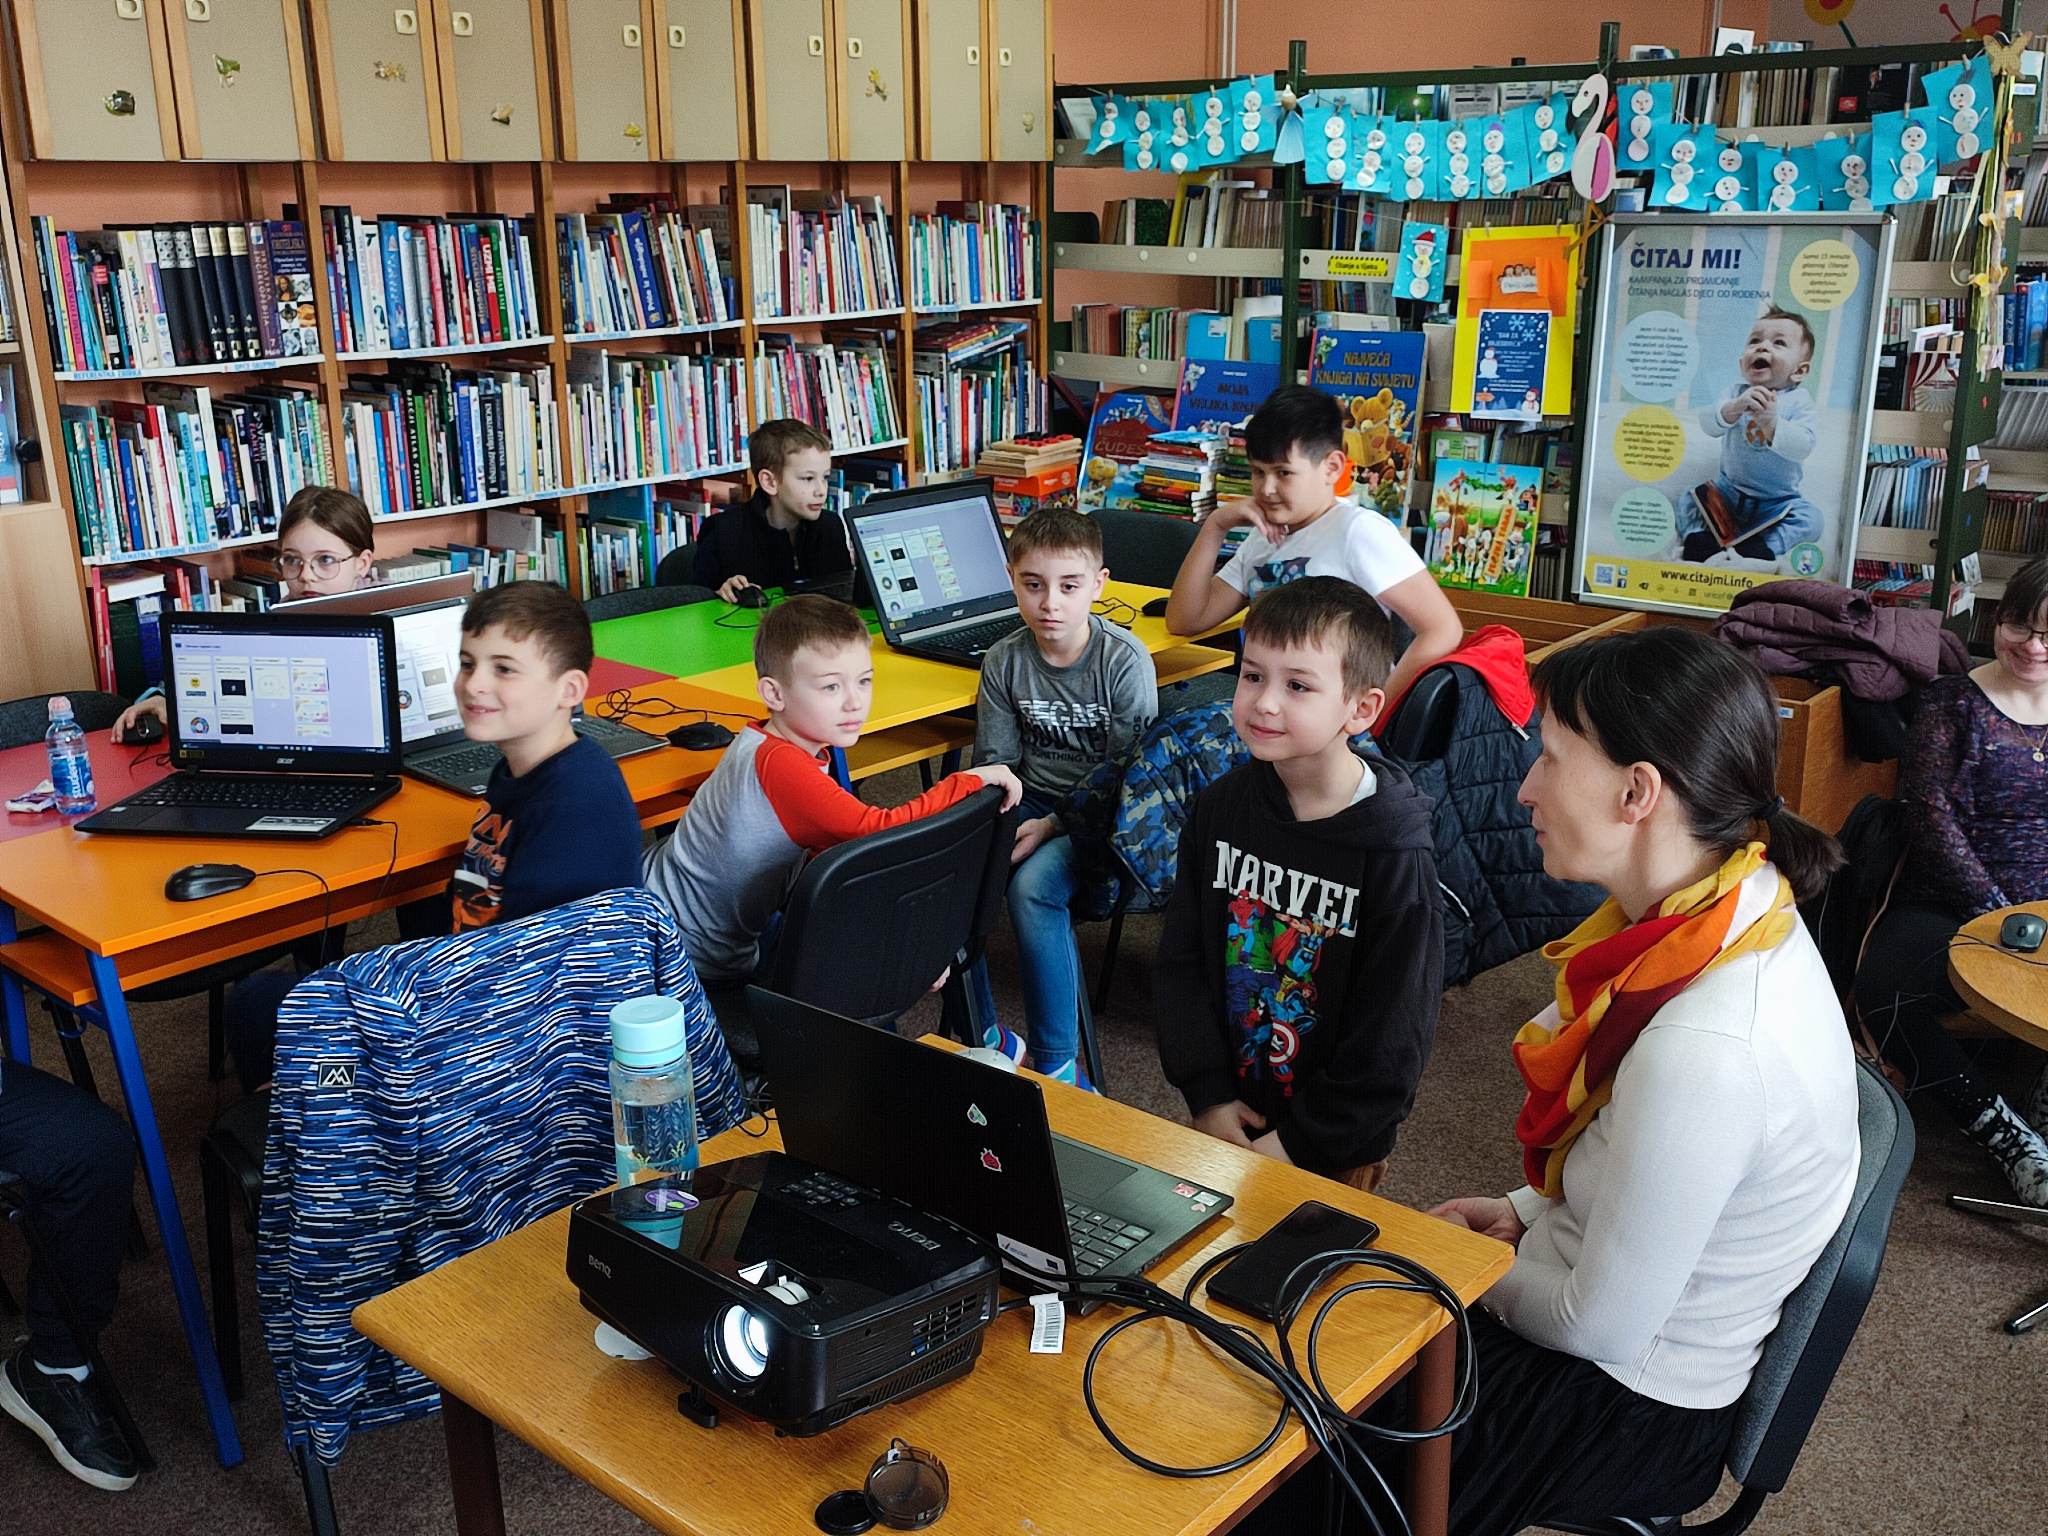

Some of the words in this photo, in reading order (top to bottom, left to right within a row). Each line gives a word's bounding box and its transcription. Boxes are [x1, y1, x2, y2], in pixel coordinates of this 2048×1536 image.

[1630, 242, 1693, 268] ČITAJ
[1701, 249, 1741, 269] MI!
[1344, 350, 1391, 367] NAJVEĆA
[1315, 369, 1353, 385] KNJIGA
[1354, 371, 1370, 386] NA
[1371, 372, 1415, 388] SVIJETU
[410, 428, 420, 459] ATLAS
[413, 463, 424, 505] PRIRODE
[1660, 568, 1753, 588] www.citajmi.info
[67, 756, 81, 798] studena
